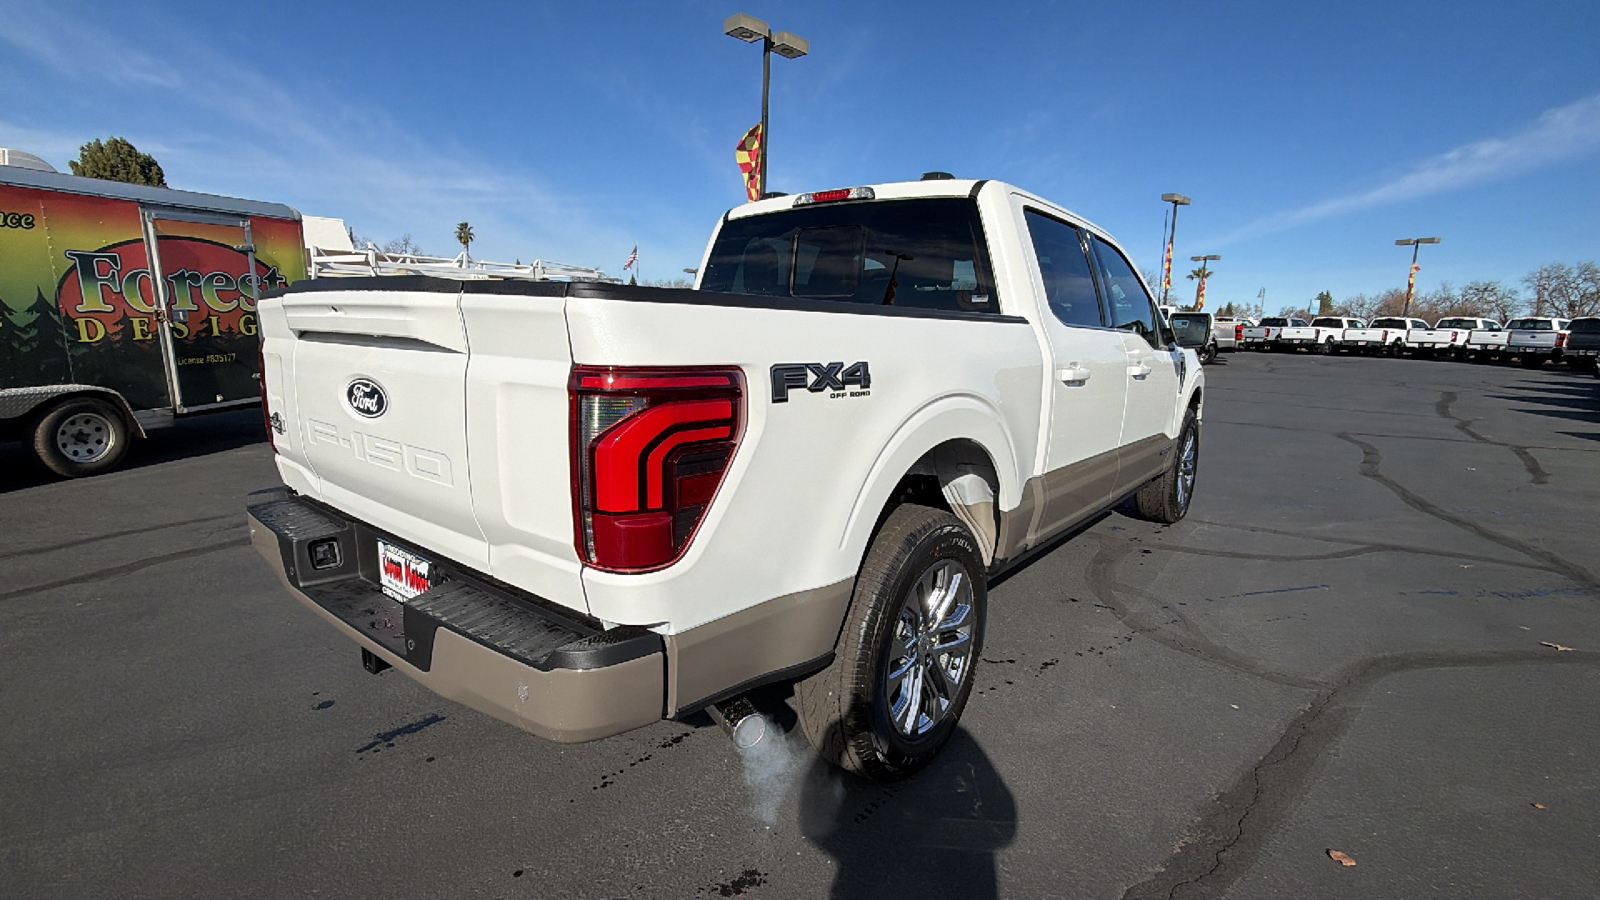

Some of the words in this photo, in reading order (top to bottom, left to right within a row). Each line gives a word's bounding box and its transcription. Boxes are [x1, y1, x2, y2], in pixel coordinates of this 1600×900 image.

[65, 250, 286, 314] Forest
[177, 357, 204, 366] License
[206, 352, 236, 364] #835177
[351, 383, 379, 412] Ford
[769, 361, 872, 404] FX4
[829, 391, 848, 399] OFF
[849, 390, 871, 398] ROAD
[306, 418, 454, 488] F-150
